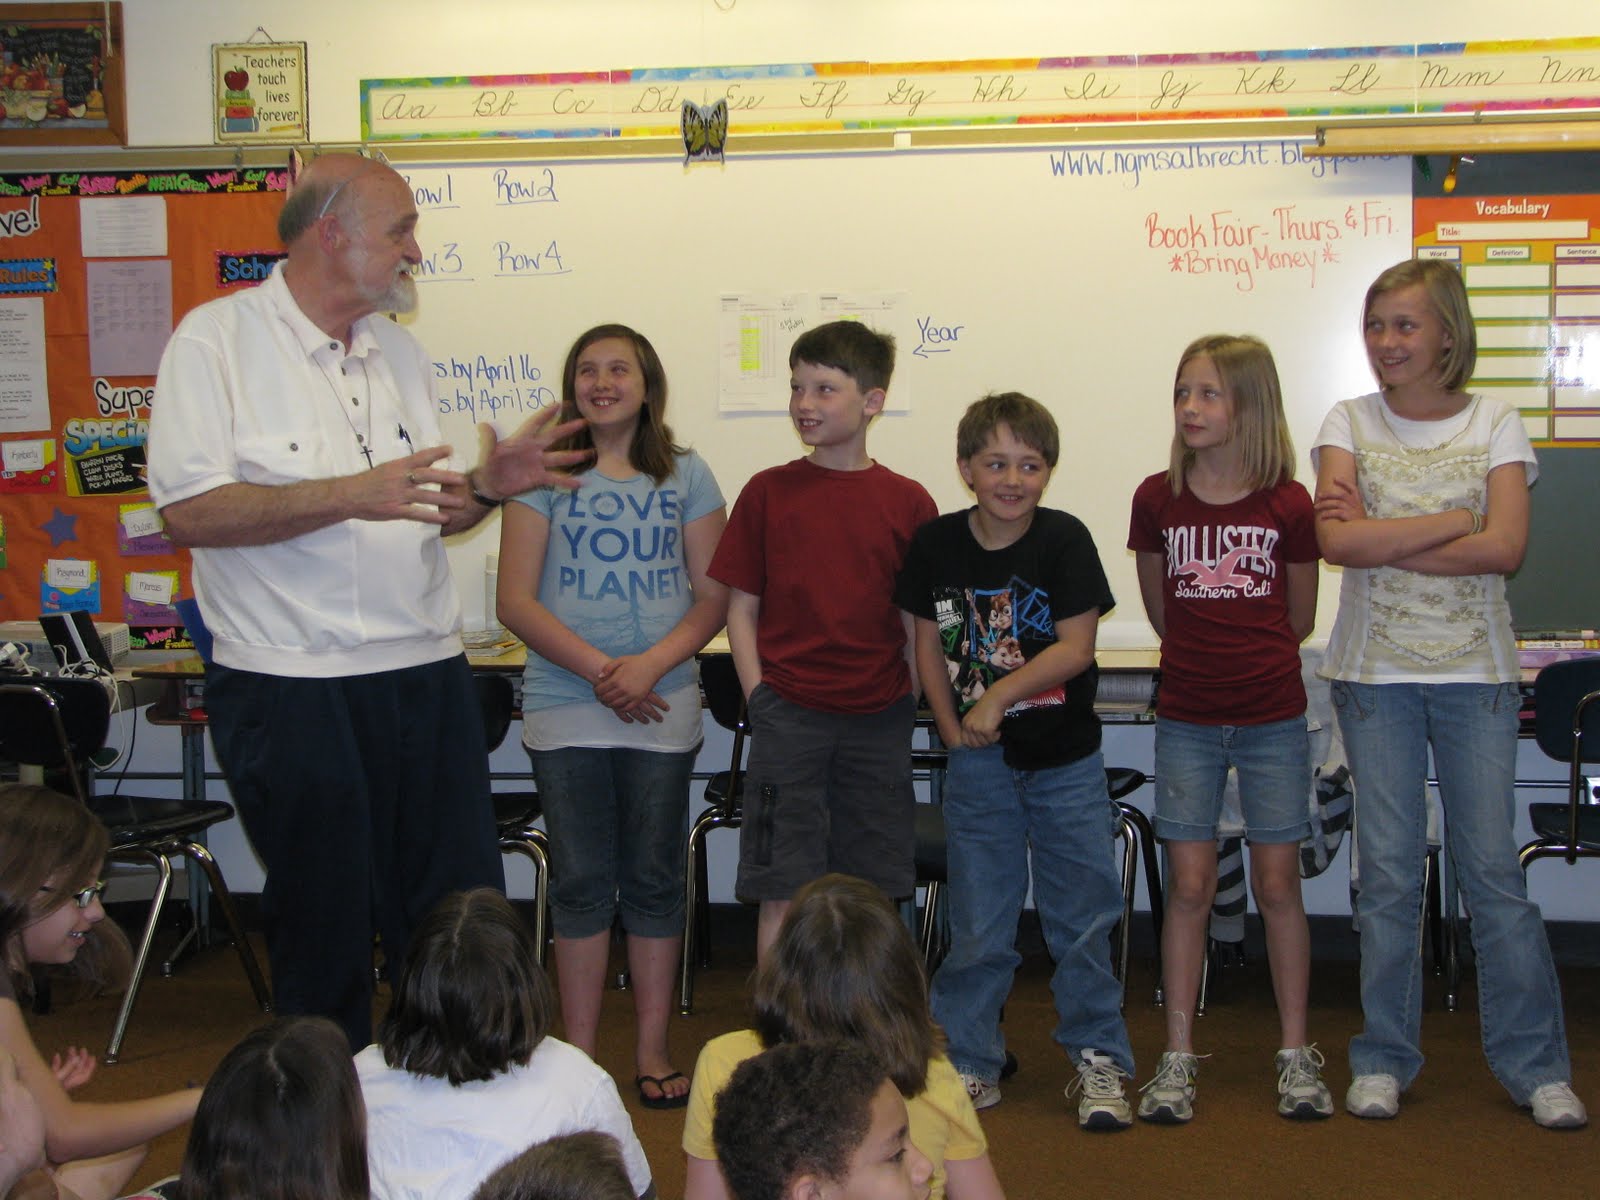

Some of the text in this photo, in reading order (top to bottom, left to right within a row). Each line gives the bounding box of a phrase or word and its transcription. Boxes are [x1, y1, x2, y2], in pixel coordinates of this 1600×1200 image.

[243, 55, 296, 69] Teachers
[257, 71, 287, 85] touch
[265, 89, 291, 103] lives
[257, 107, 300, 122] forever
[1475, 199, 1551, 219] Vocabulary
[1145, 211, 1208, 248] Book
[1440, 227, 1462, 237] Title:
[1429, 247, 1598, 258] Word Definition Sentence
[0, 267, 49, 284] Rules
[225, 257, 276, 281] Sch
[916, 315, 965, 344] Year
[476, 354, 516, 388] April
[519, 353, 542, 381] 16
[94, 380, 154, 417] Supe
[480, 387, 523, 420] April
[526, 386, 557, 410] 30
[64, 420, 150, 457] SPECIA
[567, 488, 678, 522] LOVE
[560, 524, 678, 562] YOUR
[558, 566, 681, 601] PLANET
[1175, 579, 1272, 600] Southern Cali
